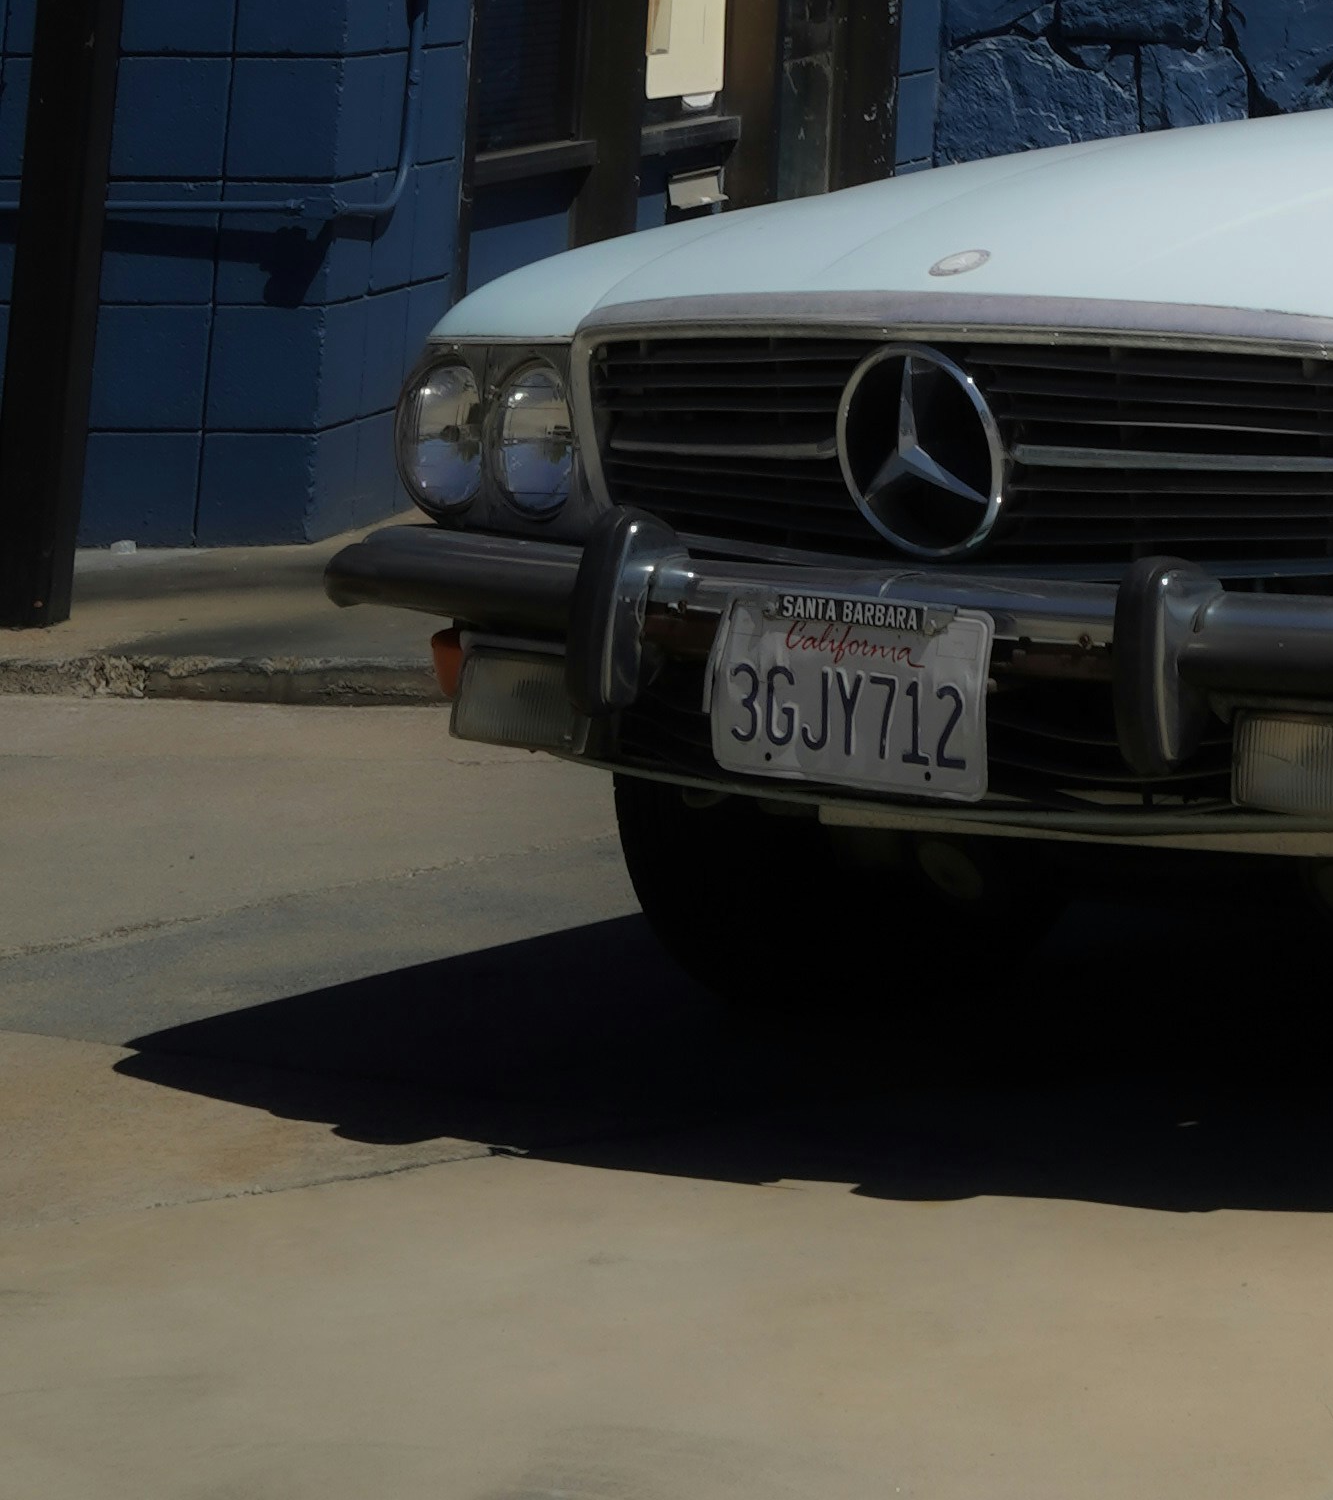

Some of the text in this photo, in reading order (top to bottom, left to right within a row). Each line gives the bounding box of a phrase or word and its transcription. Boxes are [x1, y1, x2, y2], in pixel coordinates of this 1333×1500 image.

[782, 595, 918, 631] SANTA BARBARA
[785, 620, 925, 669] California
[730, 663, 967, 771] 3GJY712
